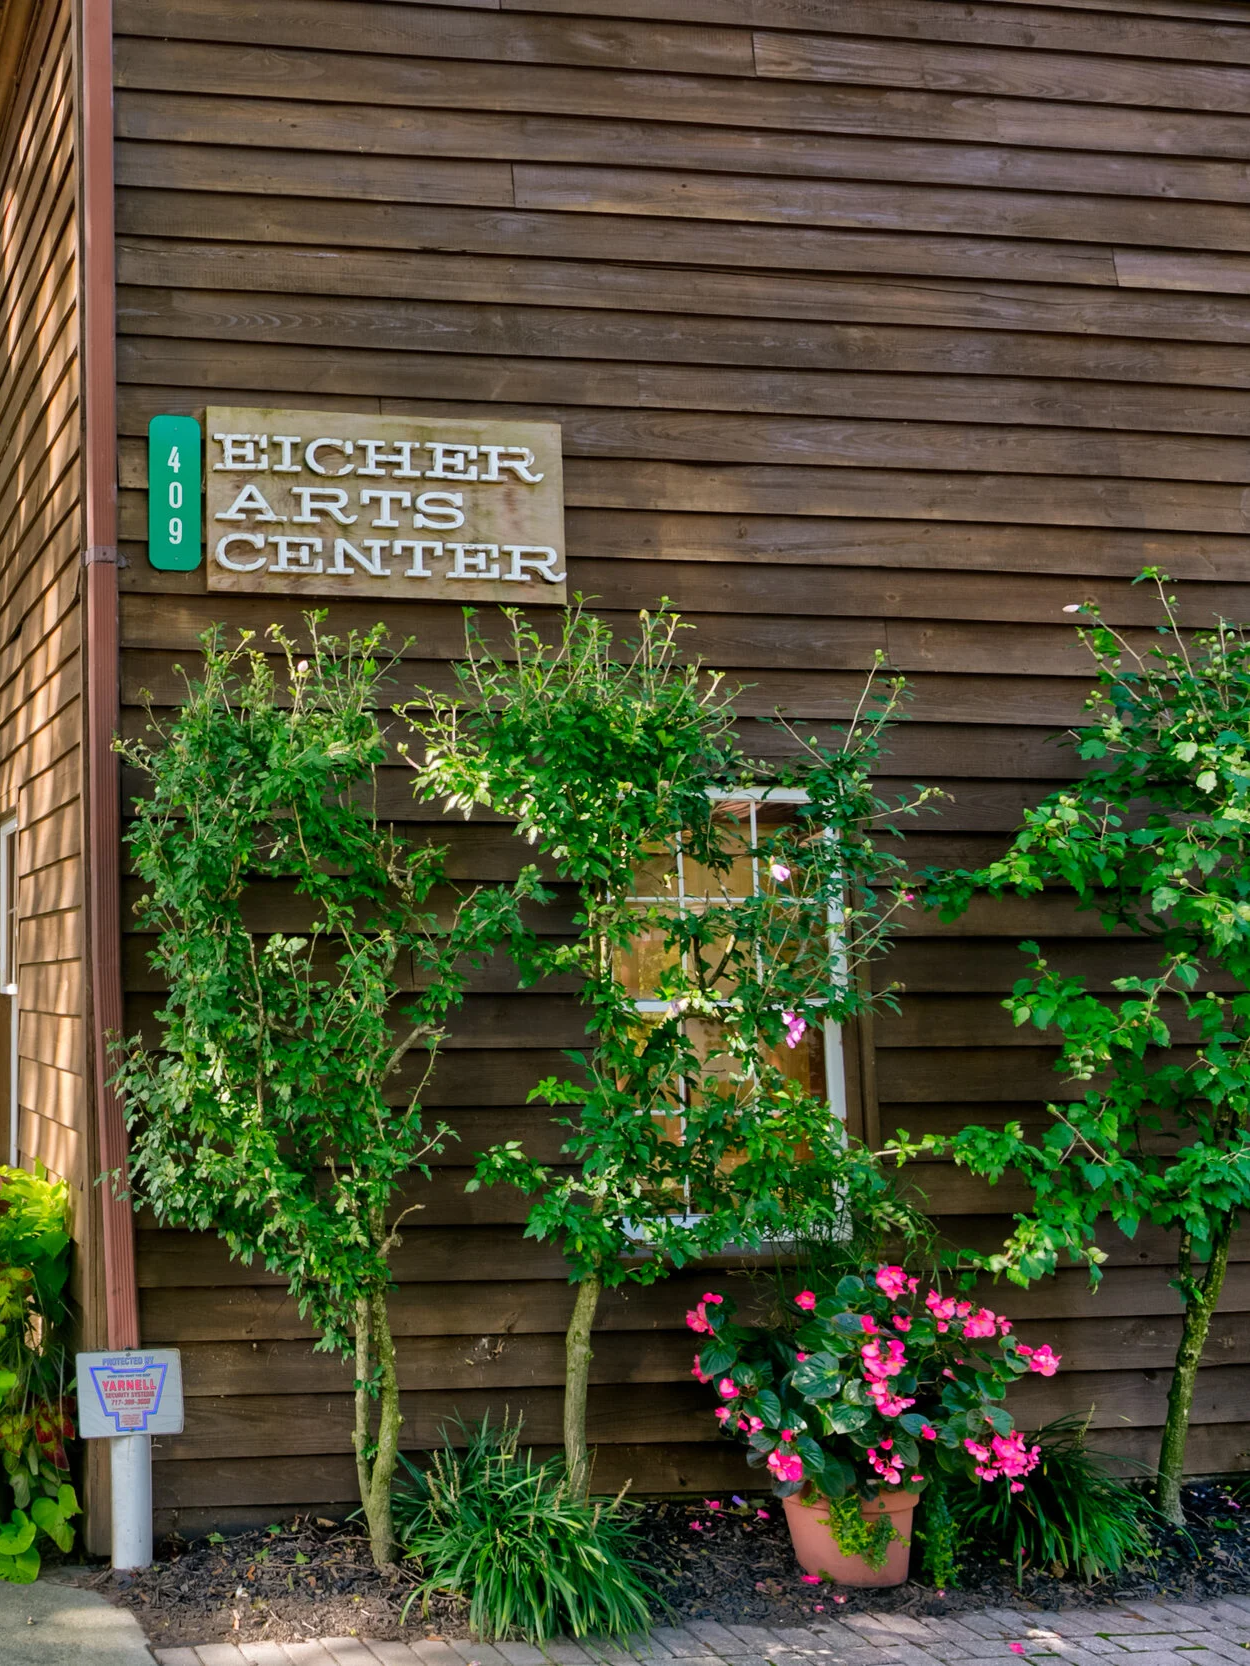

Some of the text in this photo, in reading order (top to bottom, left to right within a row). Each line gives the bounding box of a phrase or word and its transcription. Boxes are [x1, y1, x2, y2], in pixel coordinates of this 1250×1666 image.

[213, 433, 545, 484] EICHER
[167, 446, 183, 545] 409
[214, 484, 465, 530] ARTS
[215, 533, 567, 584] CENTER
[102, 1357, 143, 1366] PROTECTED
[102, 1379, 156, 1391] YARNELL
